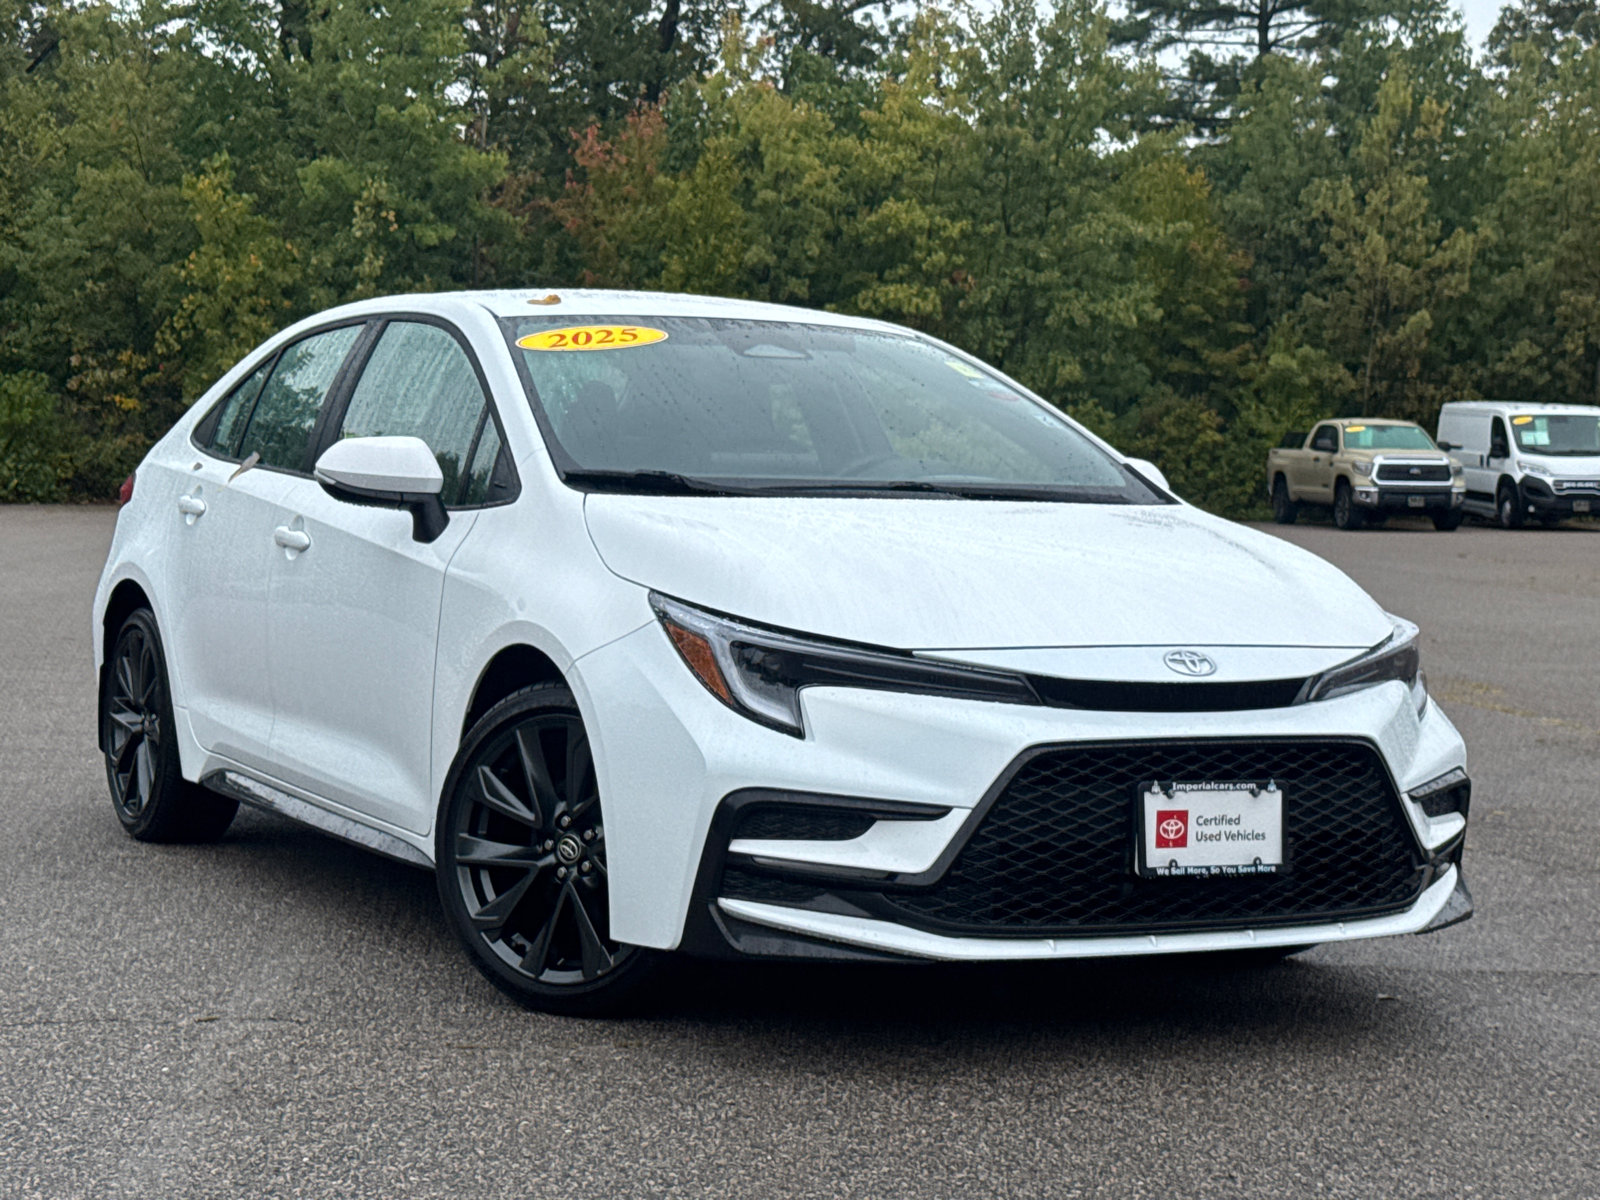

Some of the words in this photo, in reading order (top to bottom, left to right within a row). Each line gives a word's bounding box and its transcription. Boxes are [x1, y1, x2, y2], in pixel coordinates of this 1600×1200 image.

[548, 327, 638, 348] 2025
[1196, 814, 1241, 826] Certified
[1195, 830, 1222, 842] Used
[1224, 829, 1266, 842] Vehicles
[1156, 866, 1170, 876] We
[1210, 865, 1220, 874] So
[1222, 865, 1236, 874] You
[1237, 864, 1256, 873] Save
[1257, 864, 1276, 873] More
